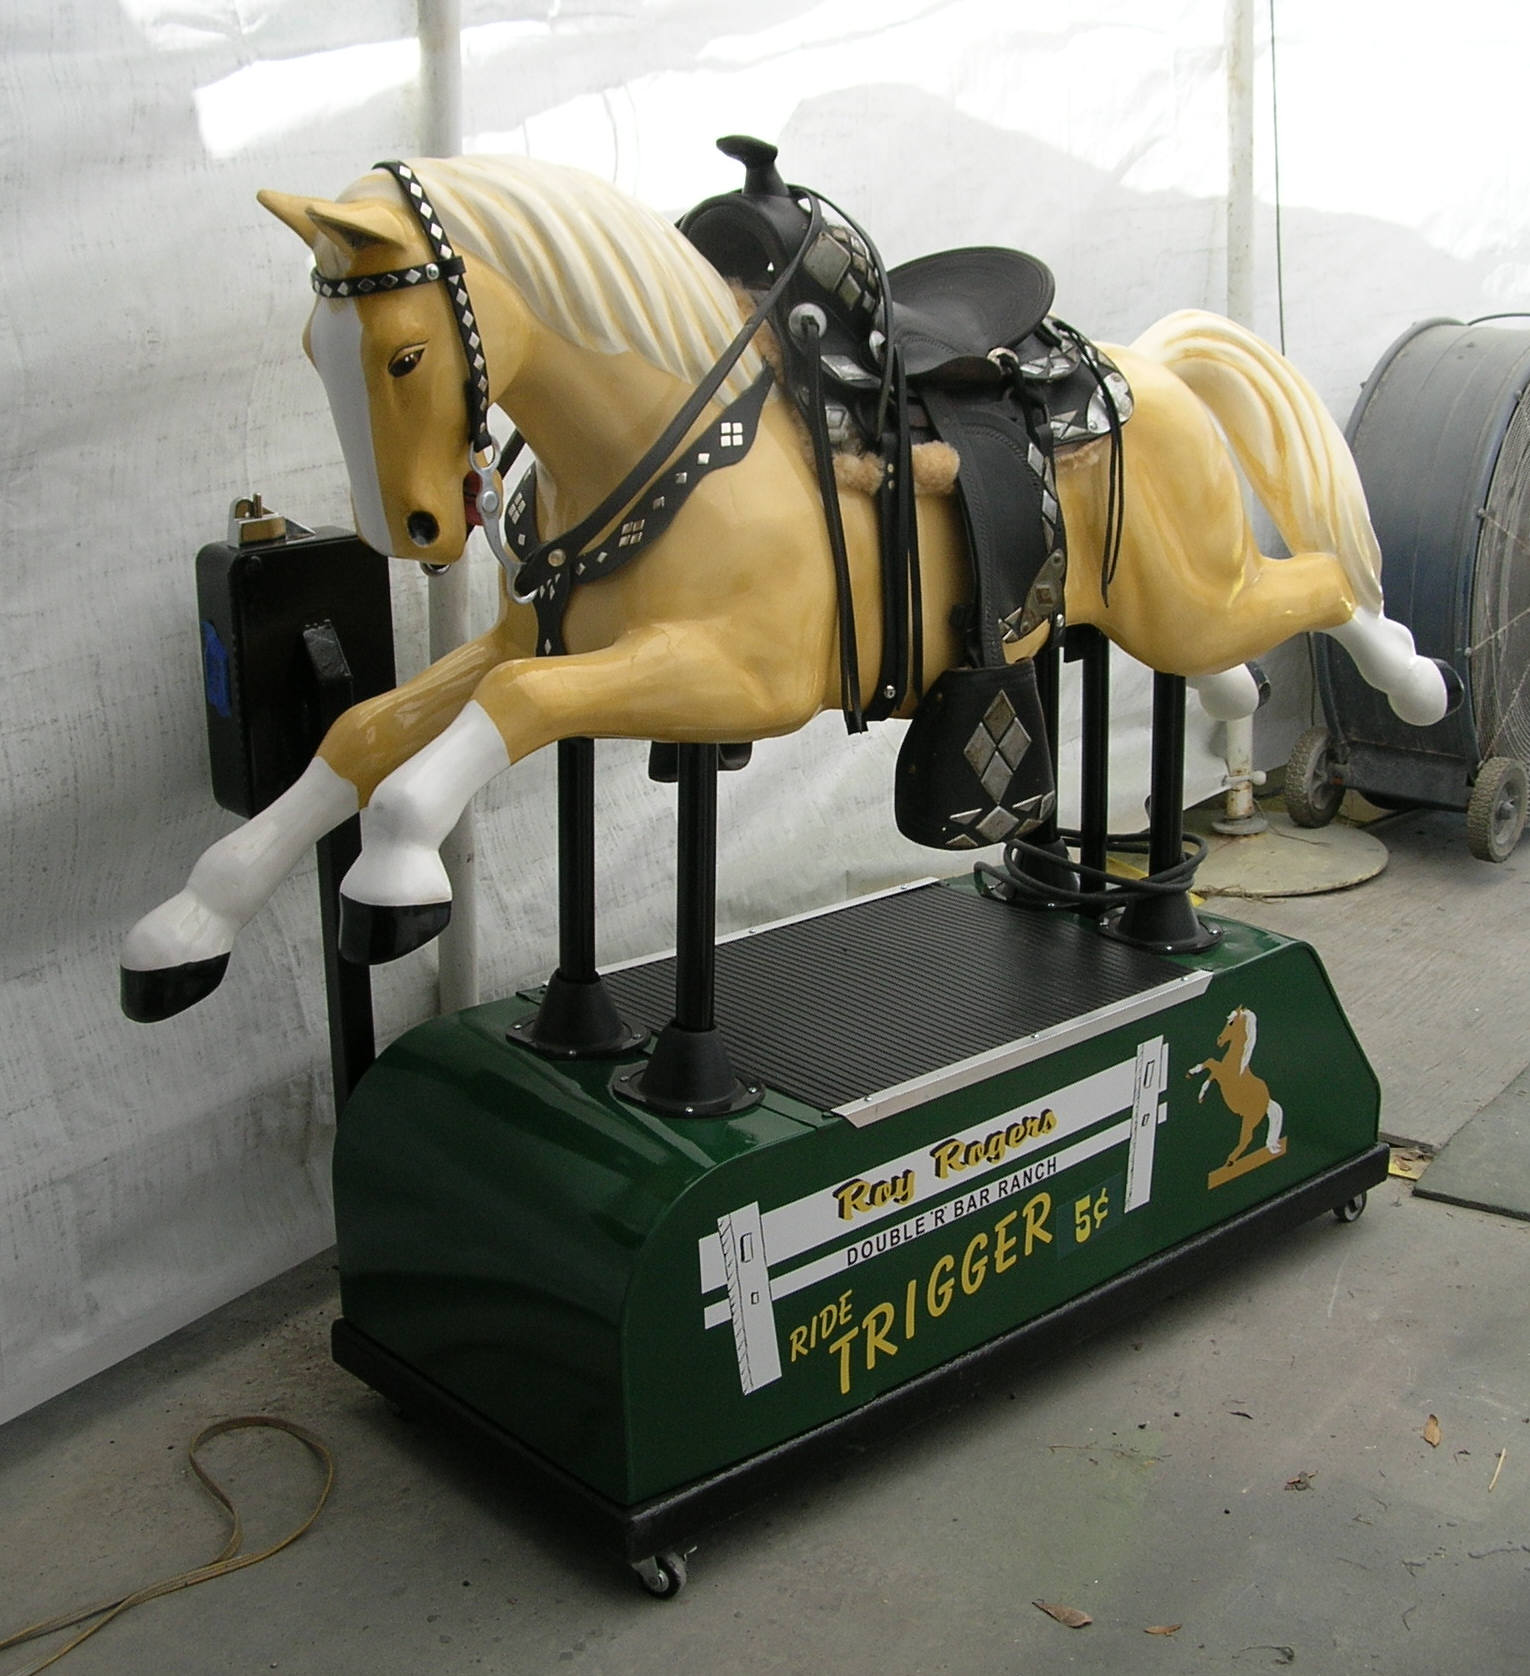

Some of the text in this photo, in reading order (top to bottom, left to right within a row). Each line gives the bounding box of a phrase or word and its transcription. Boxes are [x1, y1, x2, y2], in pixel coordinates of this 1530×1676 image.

[833, 1109, 1057, 1220] Roy Rogers
[847, 1216, 925, 1266] DOUBLE
[954, 1188, 990, 1217] BAR
[998, 1157, 1057, 1197] RANCH
[790, 1289, 852, 1362] RIDE
[829, 1188, 1109, 1394] TRIGGER 5¢
